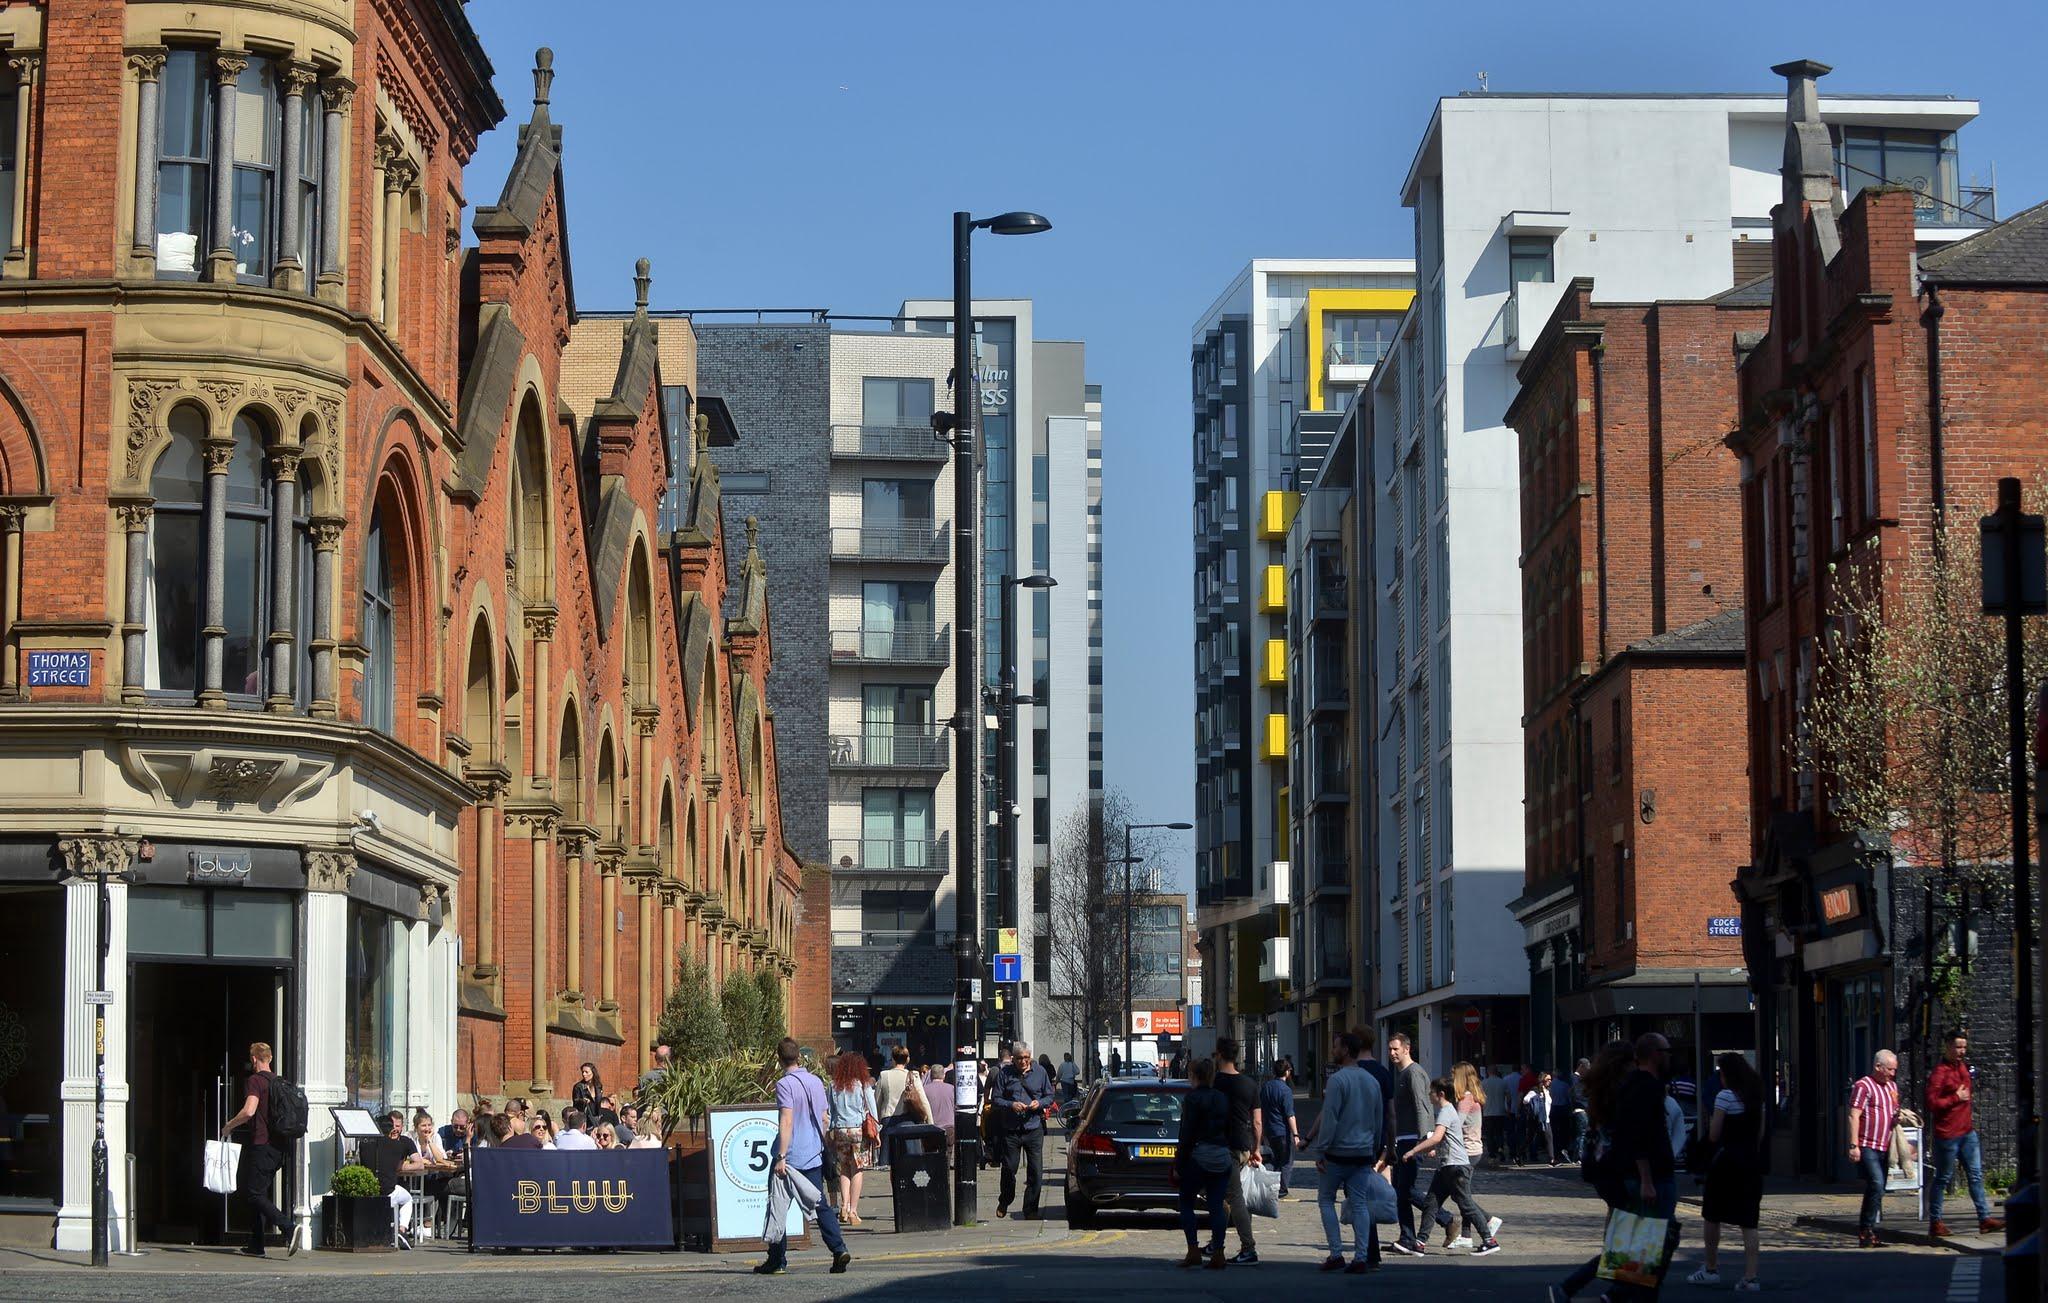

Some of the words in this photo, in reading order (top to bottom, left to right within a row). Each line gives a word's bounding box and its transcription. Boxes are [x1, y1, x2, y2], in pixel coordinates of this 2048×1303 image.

[32, 654, 87, 668] THOMAS
[32, 670, 86, 683] STREET
[1713, 918, 1735, 927] EDGE
[1709, 926, 1740, 935] STREET
[883, 1015, 917, 1028] CAT
[744, 1140, 769, 1172] £5
[518, 1180, 627, 1214] BLUU
